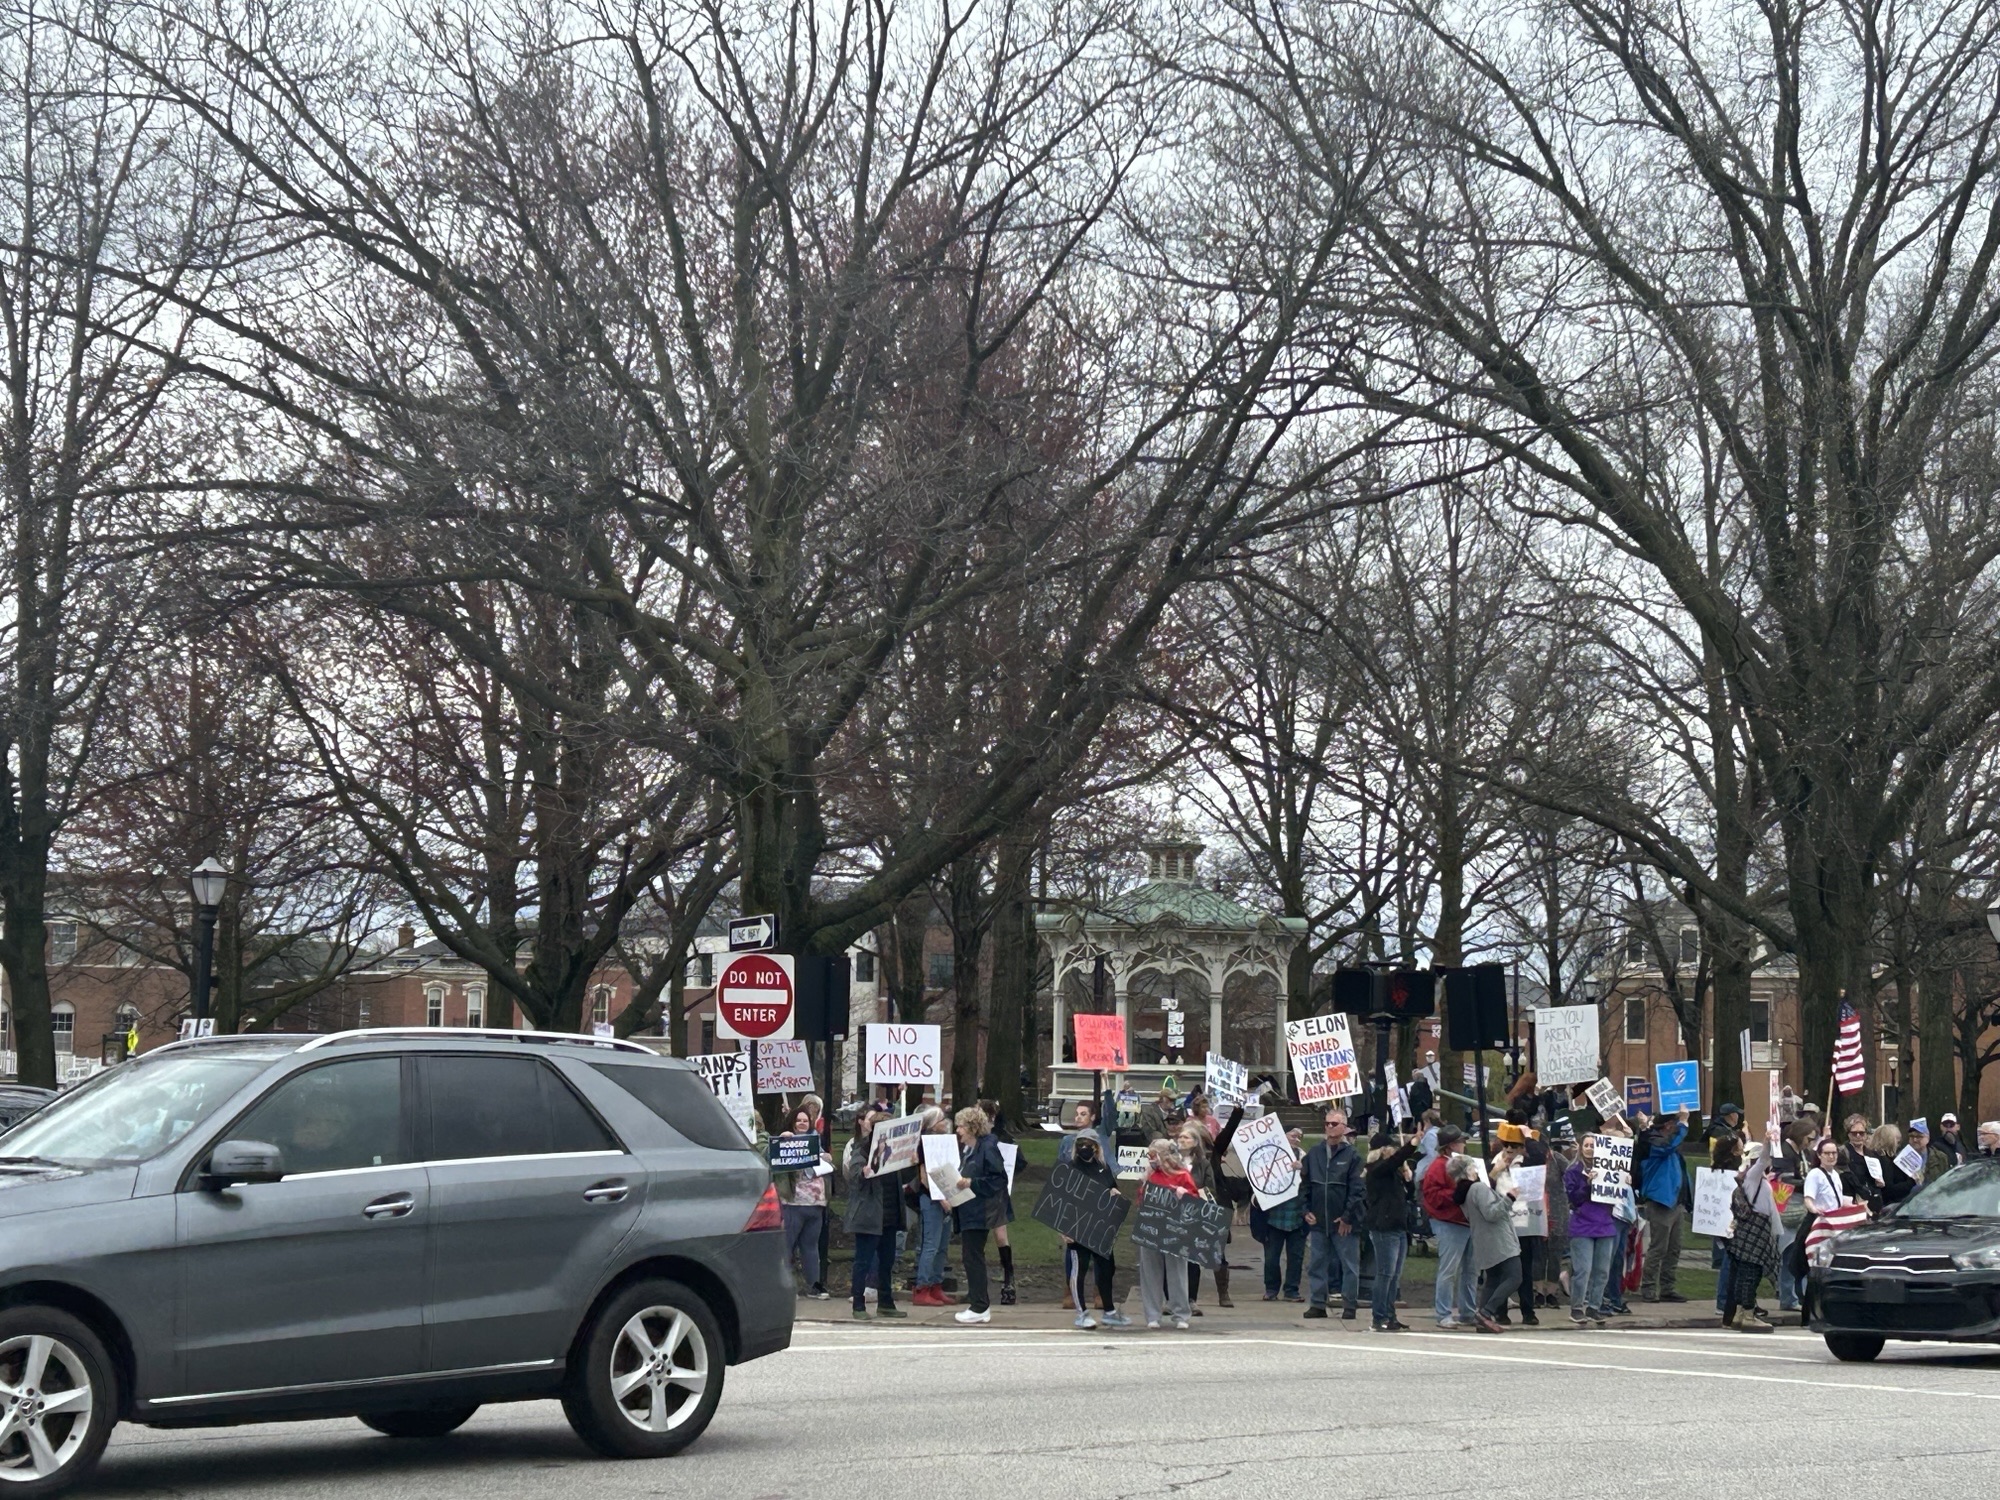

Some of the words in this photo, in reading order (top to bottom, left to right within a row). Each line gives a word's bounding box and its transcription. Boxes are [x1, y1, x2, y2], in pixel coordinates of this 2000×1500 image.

[729, 971, 748, 985] DO
[755, 971, 782, 985] NOT
[734, 1008, 777, 1022] ENTER
[1538, 1011, 1557, 1025] IF
[1560, 1010, 1584, 1025] YOU
[888, 1027, 917, 1044] NO
[1286, 1021, 1301, 1041] HEY
[1304, 1014, 1346, 1036] ELON
[776, 1042, 803, 1053] THE
[1290, 1037, 1340, 1057] DISABLED
[756, 1057, 796, 1069] STEAL
[874, 1053, 933, 1077] KINGS
[1300, 1048, 1355, 1071] VETERANS
[703, 1073, 742, 1096] FF!
[757, 1076, 811, 1089] EMOCRACY
[1303, 1070, 1326, 1086] ARE
[1237, 1117, 1274, 1143] STOP
[1595, 1136, 1612, 1149] WE
[1610, 1145, 1633, 1158] ARE
[1251, 1154, 1293, 1186] HATE
[1594, 1157, 1631, 1173] EQUAL
[1603, 1171, 1620, 1184] AS
[1051, 1163, 1099, 1200] GULF
[1097, 1187, 1122, 1217] OF
[1143, 1184, 1178, 1209] HANDS
[1201, 1201, 1225, 1221] OFF
[1035, 1193, 1117, 1254] MEXICO
